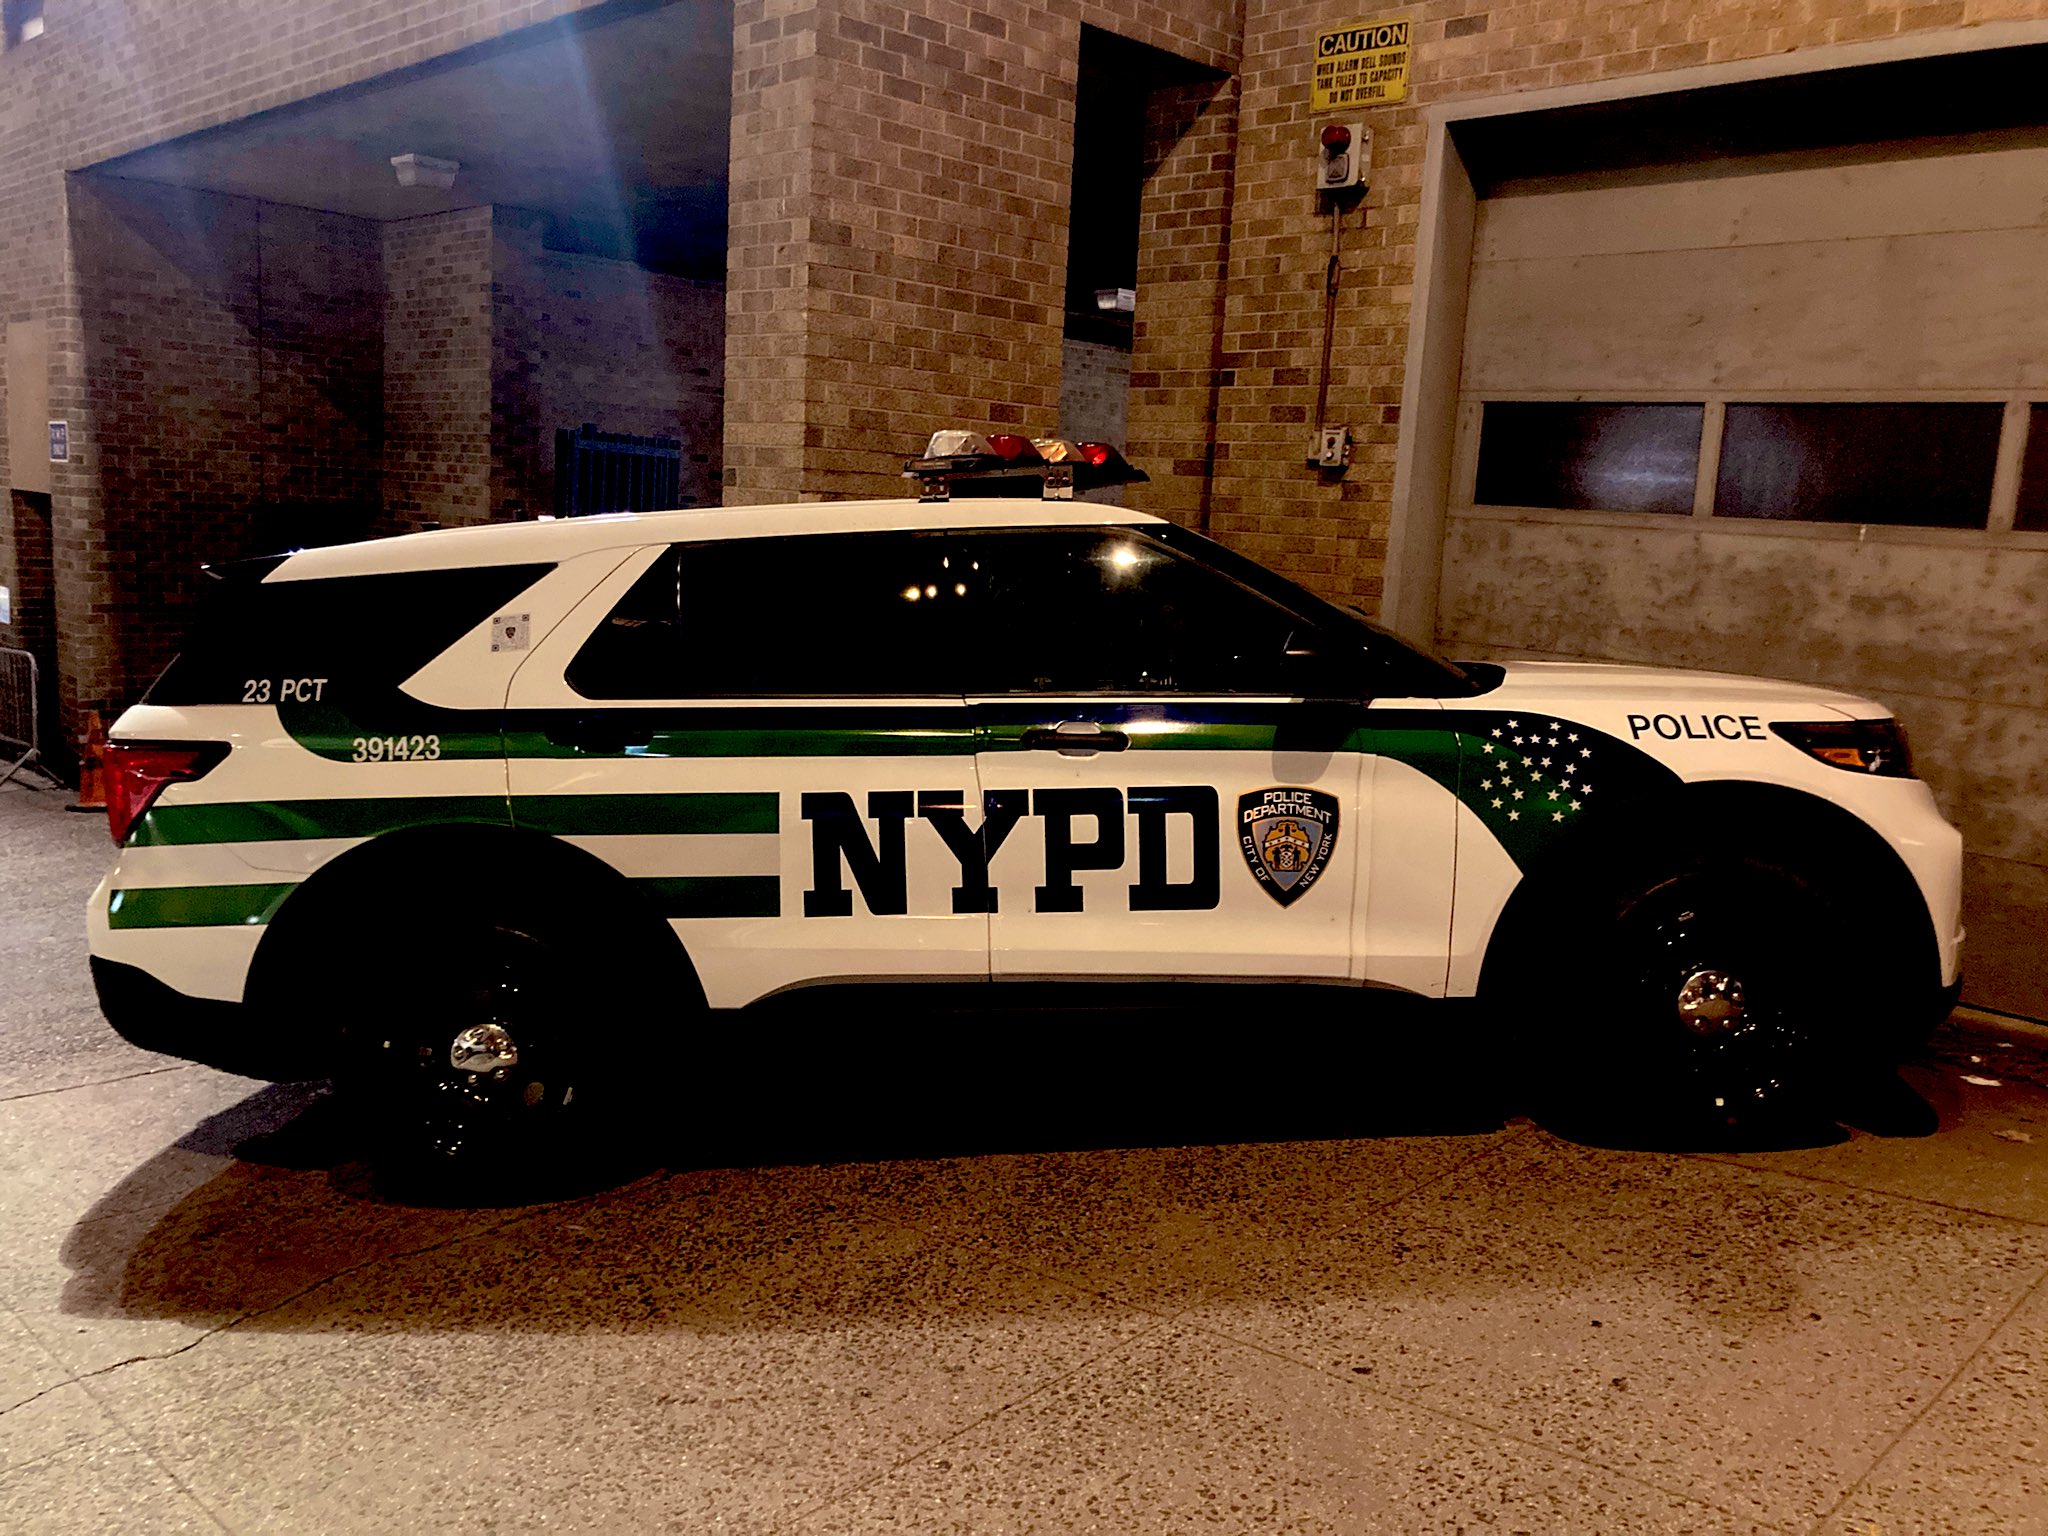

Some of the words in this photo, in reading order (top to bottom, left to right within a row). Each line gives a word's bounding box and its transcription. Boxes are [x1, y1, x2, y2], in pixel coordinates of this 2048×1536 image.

[1321, 24, 1406, 55] CAUTION
[1337, 58, 1359, 72] ALARM
[1361, 56, 1376, 69] BELL
[1379, 52, 1406, 67] SOUNDS
[1317, 77, 1333, 91] TANK
[1336, 73, 1356, 88] FILLED
[1359, 72, 1367, 85] TO
[1370, 68, 1403, 83] CAPACITY
[1329, 91, 1338, 104] DO
[1340, 89, 1353, 102] NOT
[1355, 85, 1385, 100] OVERFILL
[242, 679, 271, 702] 23
[280, 678, 328, 702] PCT
[1627, 713, 1767, 740] POLICE
[352, 735, 440, 762] 391423
[1264, 791, 1312, 804] POLICE
[1243, 803, 1332, 824] DEPARTMENT
[801, 785, 1220, 918] NYPD
[1242, 836, 1259, 863] CITY
[1255, 867, 1270, 881] OF
[1299, 863, 1320, 888] NEW
[1316, 833, 1333, 861] YORK
